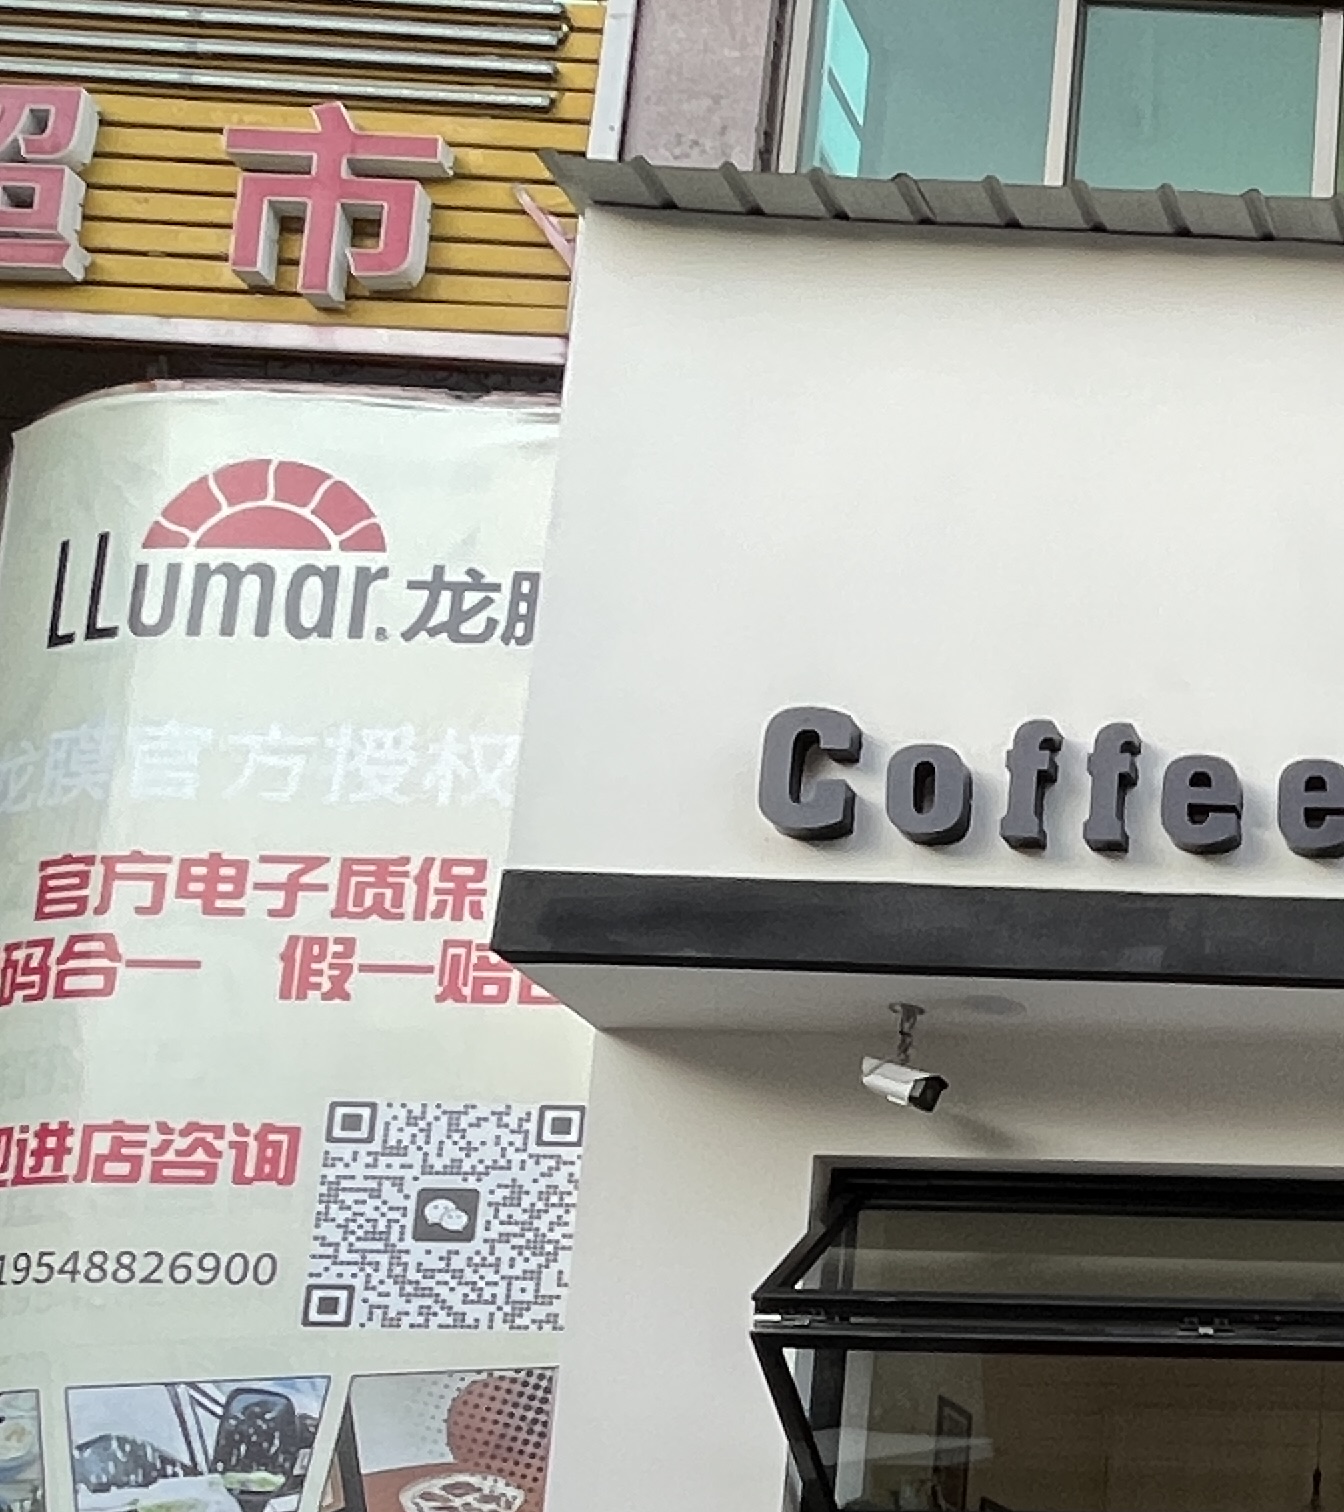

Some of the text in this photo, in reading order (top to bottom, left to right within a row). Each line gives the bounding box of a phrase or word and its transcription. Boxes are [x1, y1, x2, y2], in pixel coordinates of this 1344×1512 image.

[34, 851, 489, 922] 官方电子质保
